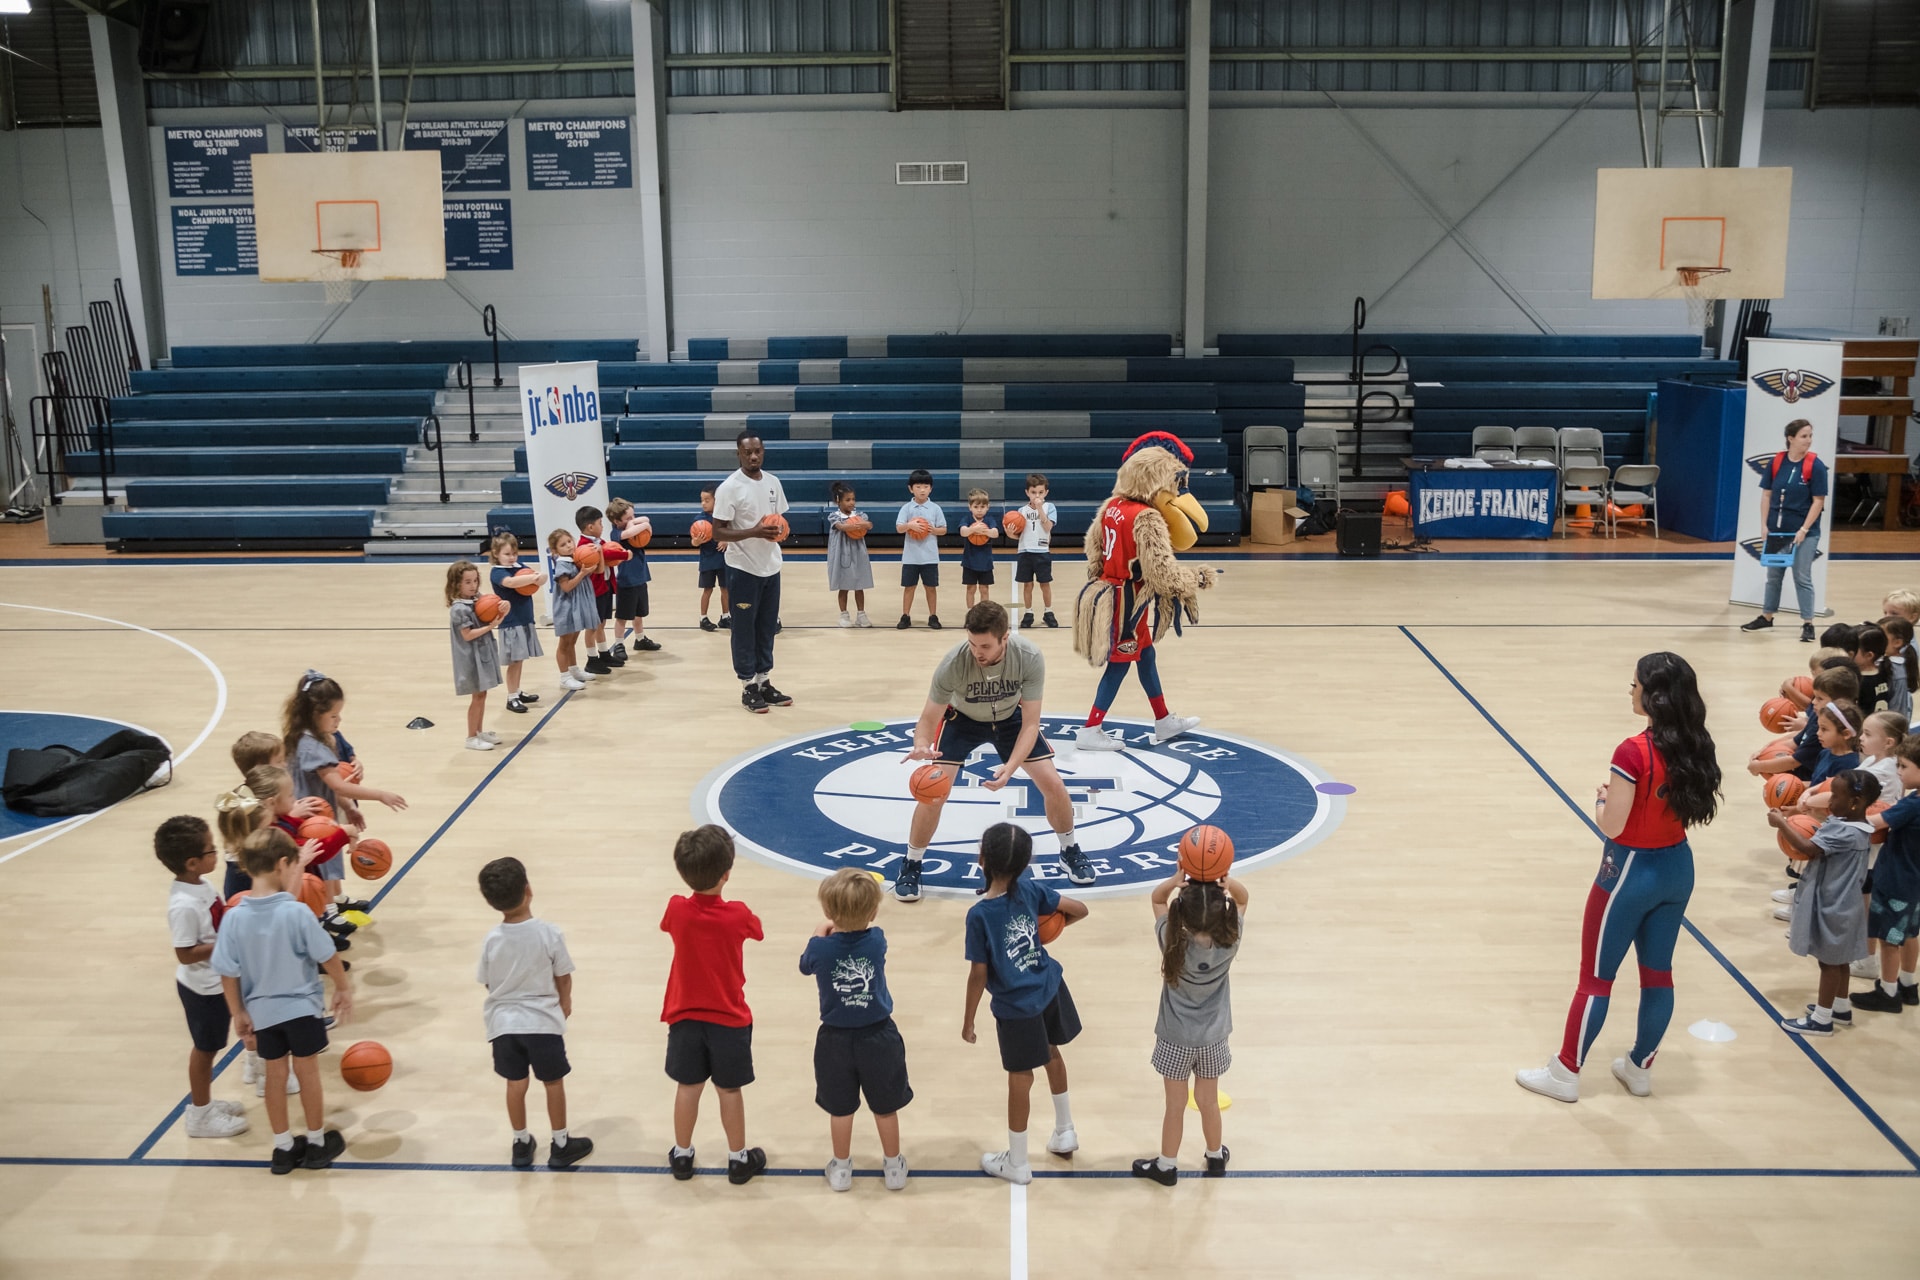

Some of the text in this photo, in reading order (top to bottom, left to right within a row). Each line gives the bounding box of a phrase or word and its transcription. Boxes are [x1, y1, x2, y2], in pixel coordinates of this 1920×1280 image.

[406, 122, 420, 130] NEW
[450, 121, 480, 129] ATHLETIC
[528, 120, 626, 131] METRO CHAMPIONS
[168, 129, 263, 139] METRO CHAMPIONS
[422, 130, 461, 138] BASKETBALL
[462, 129, 498, 137] CHAMPIONS
[574, 131, 600, 139] TENNIS
[193, 139, 239, 148] GIRLS TENNIS
[567, 139, 589, 147] 2019
[466, 203, 503, 211] FOOTBALL
[200, 208, 226, 216] JUNIOR
[473, 211, 491, 219] 2020
[236, 216, 253, 224] 2019
[527, 384, 598, 436] jr. nba
[1418, 488, 1549, 525] KEHOE-FRANCE
[967, 679, 1020, 697] PELICANS
